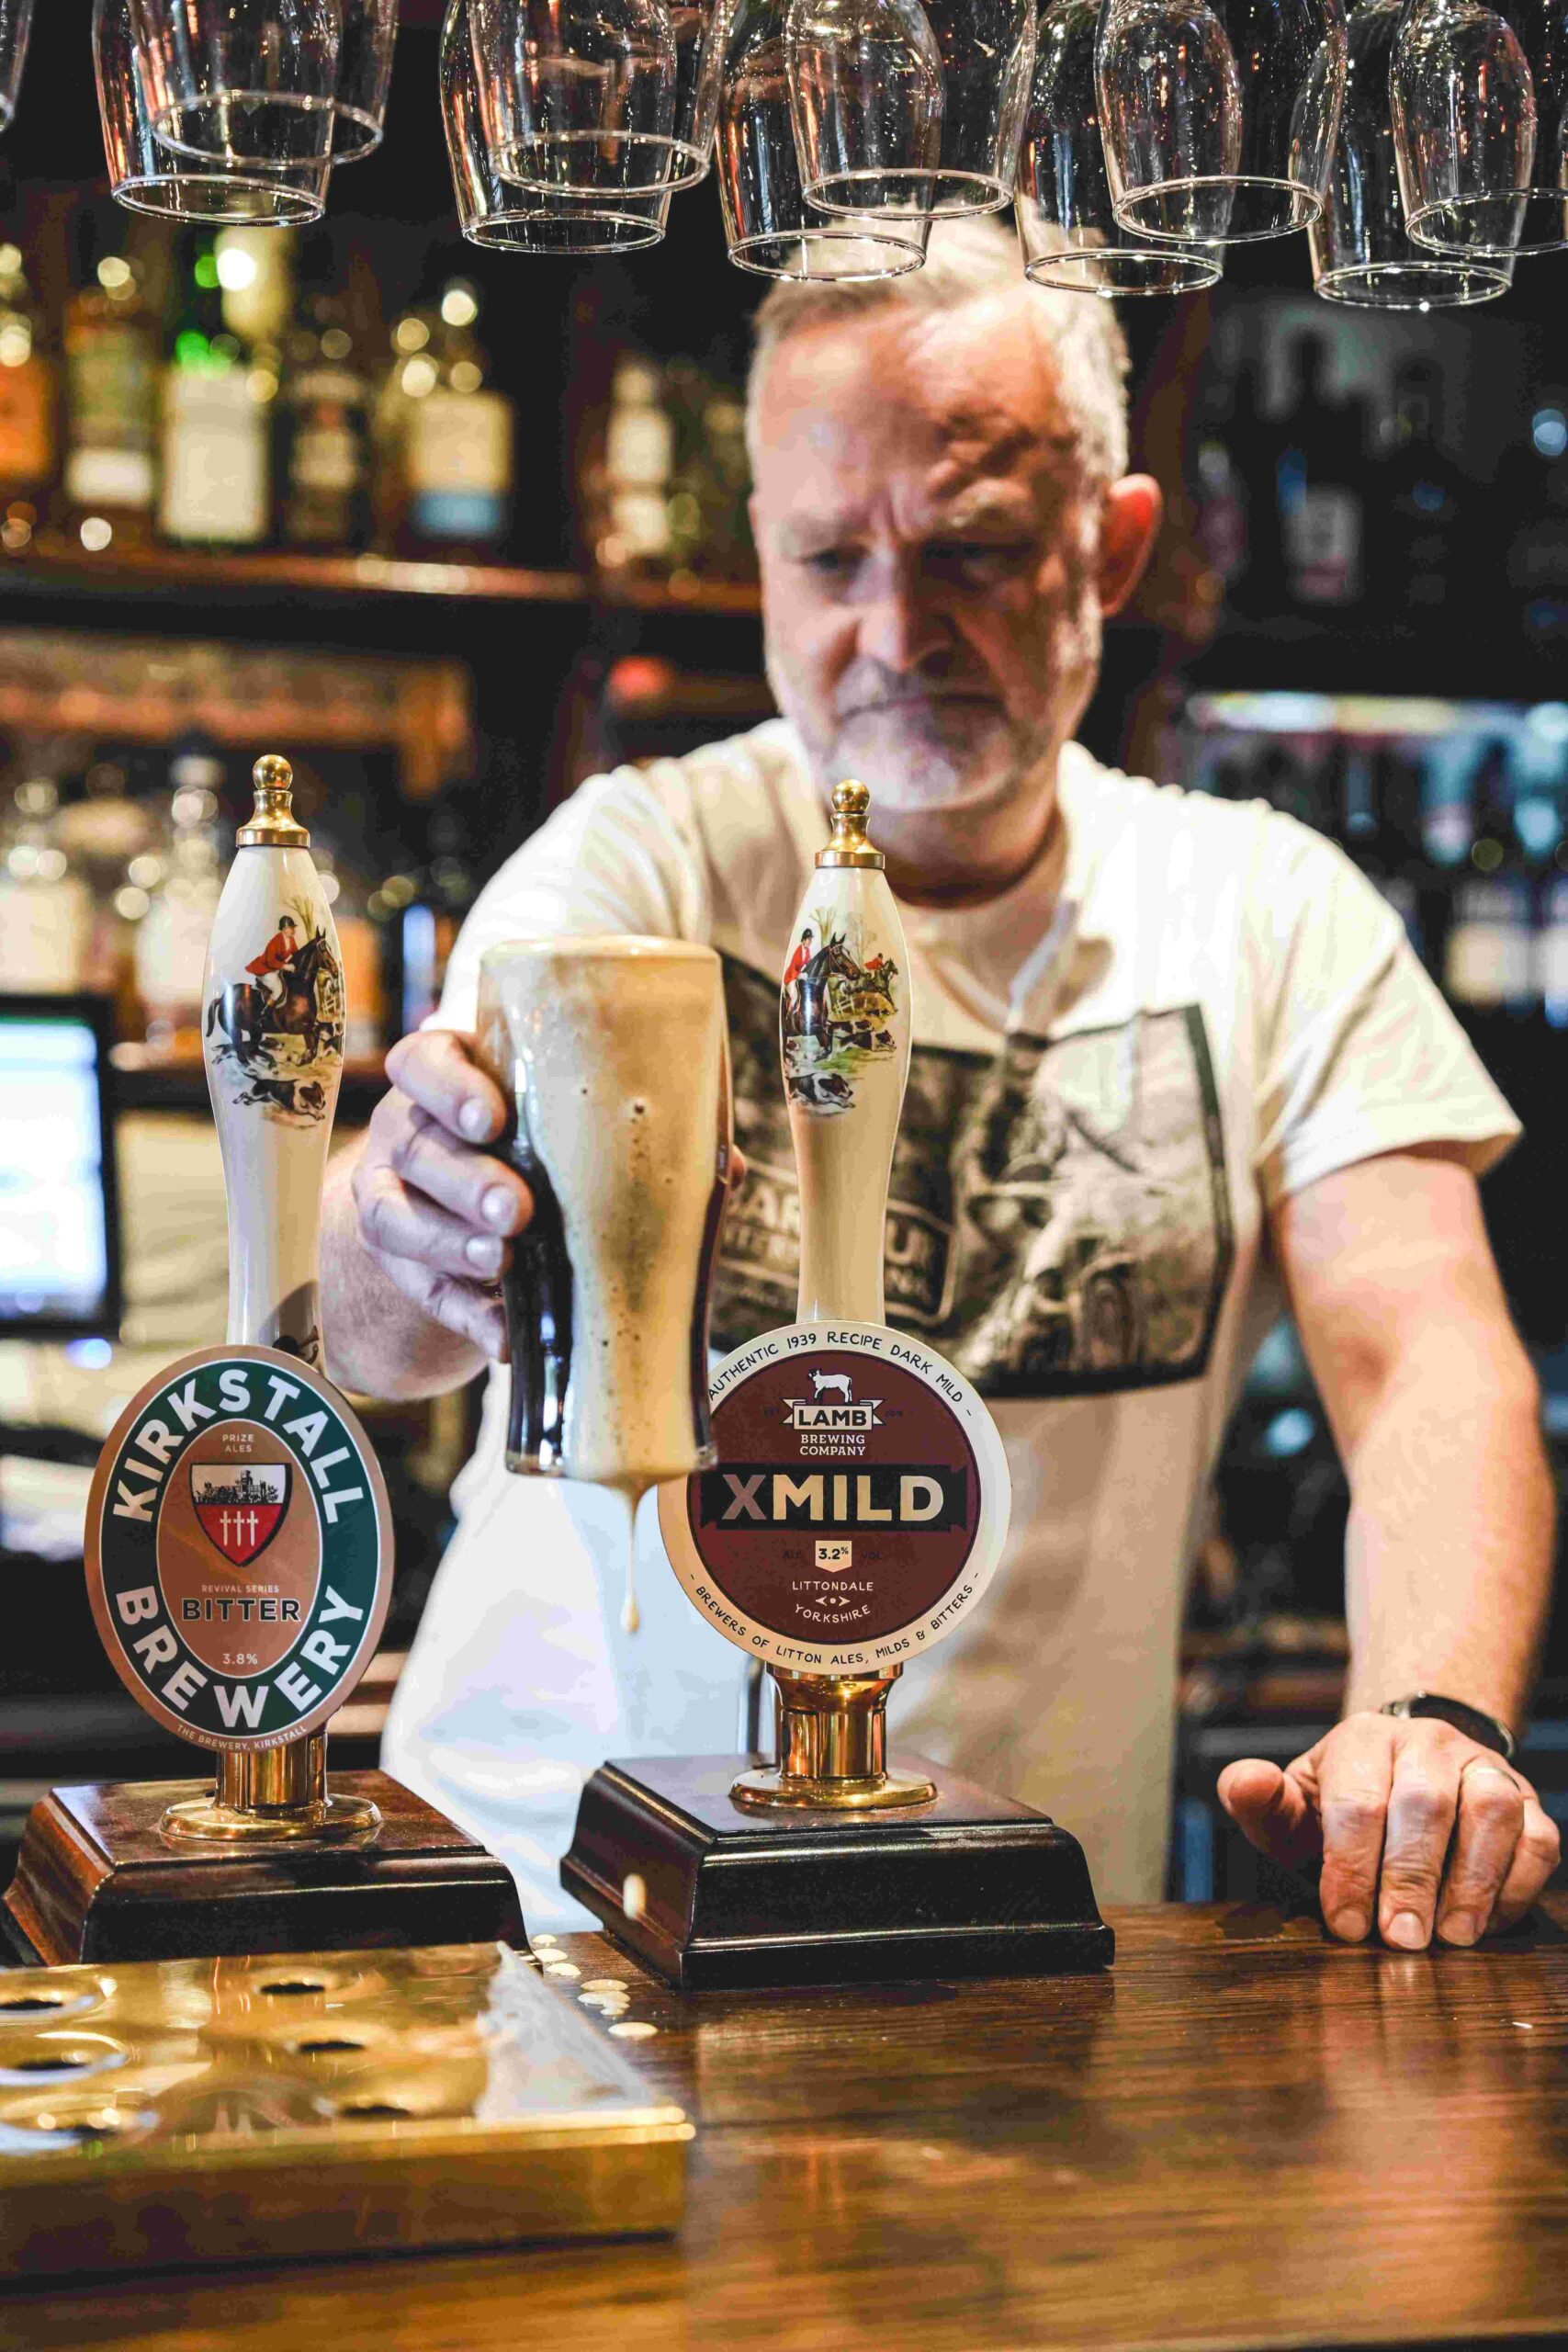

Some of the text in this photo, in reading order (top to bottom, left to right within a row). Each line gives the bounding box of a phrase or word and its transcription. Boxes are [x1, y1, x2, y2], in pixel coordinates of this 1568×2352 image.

[708, 1331, 963, 1402] AUTHENTIC 1939 RECIPE DARK MILD
[798, 1409, 867, 1426] LAMB
[222, 1433, 254, 1442] PRIZE
[800, 1434, 865, 1444] BREWING
[112, 1369, 364, 1524] KIRKSTALL
[224, 1444, 253, 1453] ALES
[799, 1445, 865, 1456] COMPANY
[721, 1474, 944, 1521] XMILD
[818, 1546, 849, 1560] 3.2%
[201, 1584, 279, 1594] REVIVAL SERIES
[792, 1580, 874, 1591] LITTONDALE
[181, 1598, 301, 1622] BITTER
[794, 1603, 872, 1623] YORKSHIRE
[695, 1584, 973, 1665] BREWERS OF LITTON ALES, MILDS & BITTERS
[116, 1585, 364, 1728] BREWERY
[222, 1653, 258, 1665] 3.8%
[177, 1724, 308, 1751] THE BREWERY, KIRKSTALL
